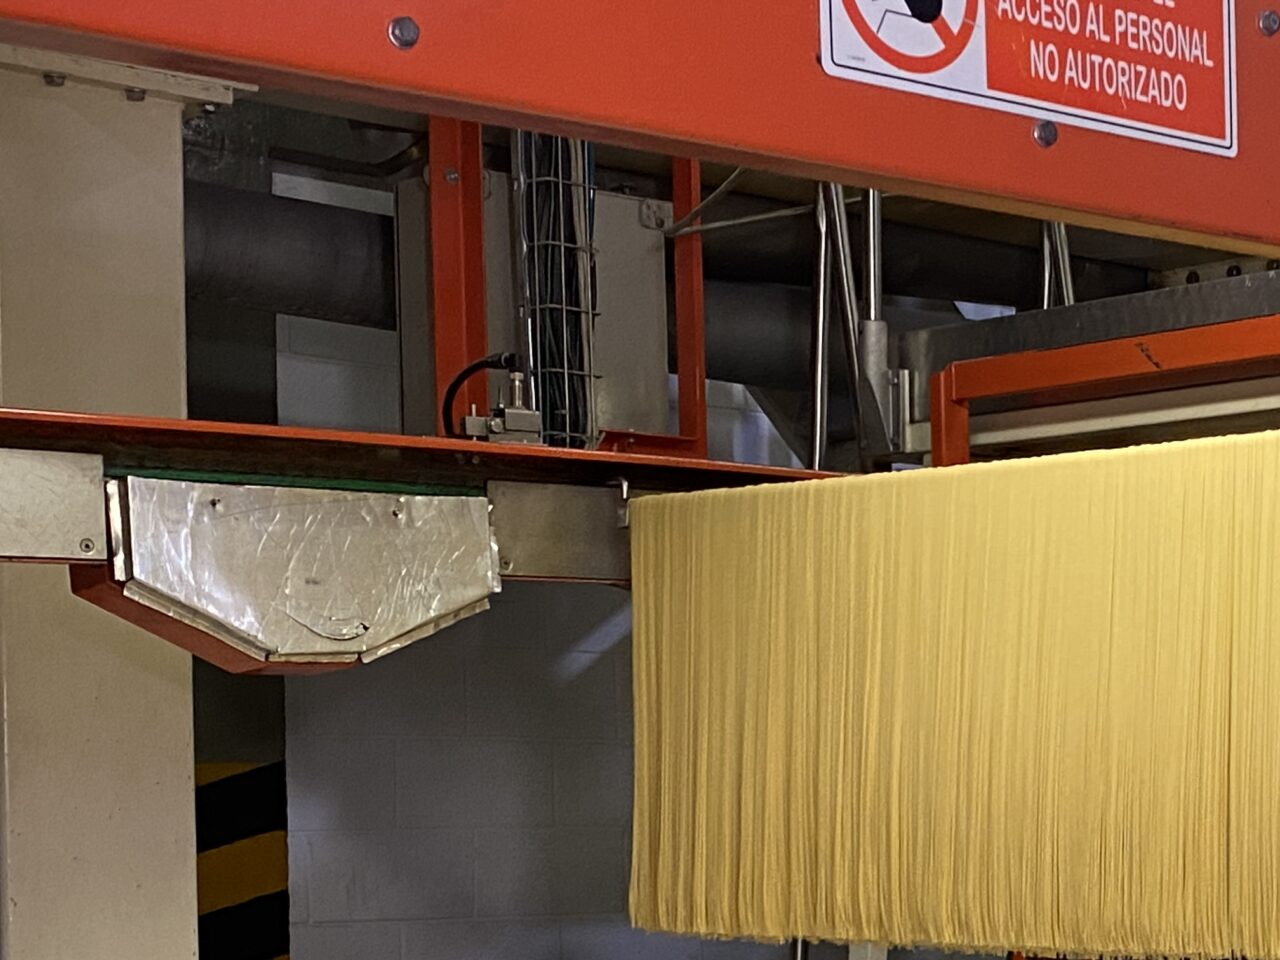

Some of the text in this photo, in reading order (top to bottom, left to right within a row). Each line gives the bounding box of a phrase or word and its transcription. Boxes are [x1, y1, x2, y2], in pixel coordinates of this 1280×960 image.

[997, 0, 1214, 67] ACCESO AL PERSONAL
[1029, 39, 1187, 110] NO AUTORIZADO
